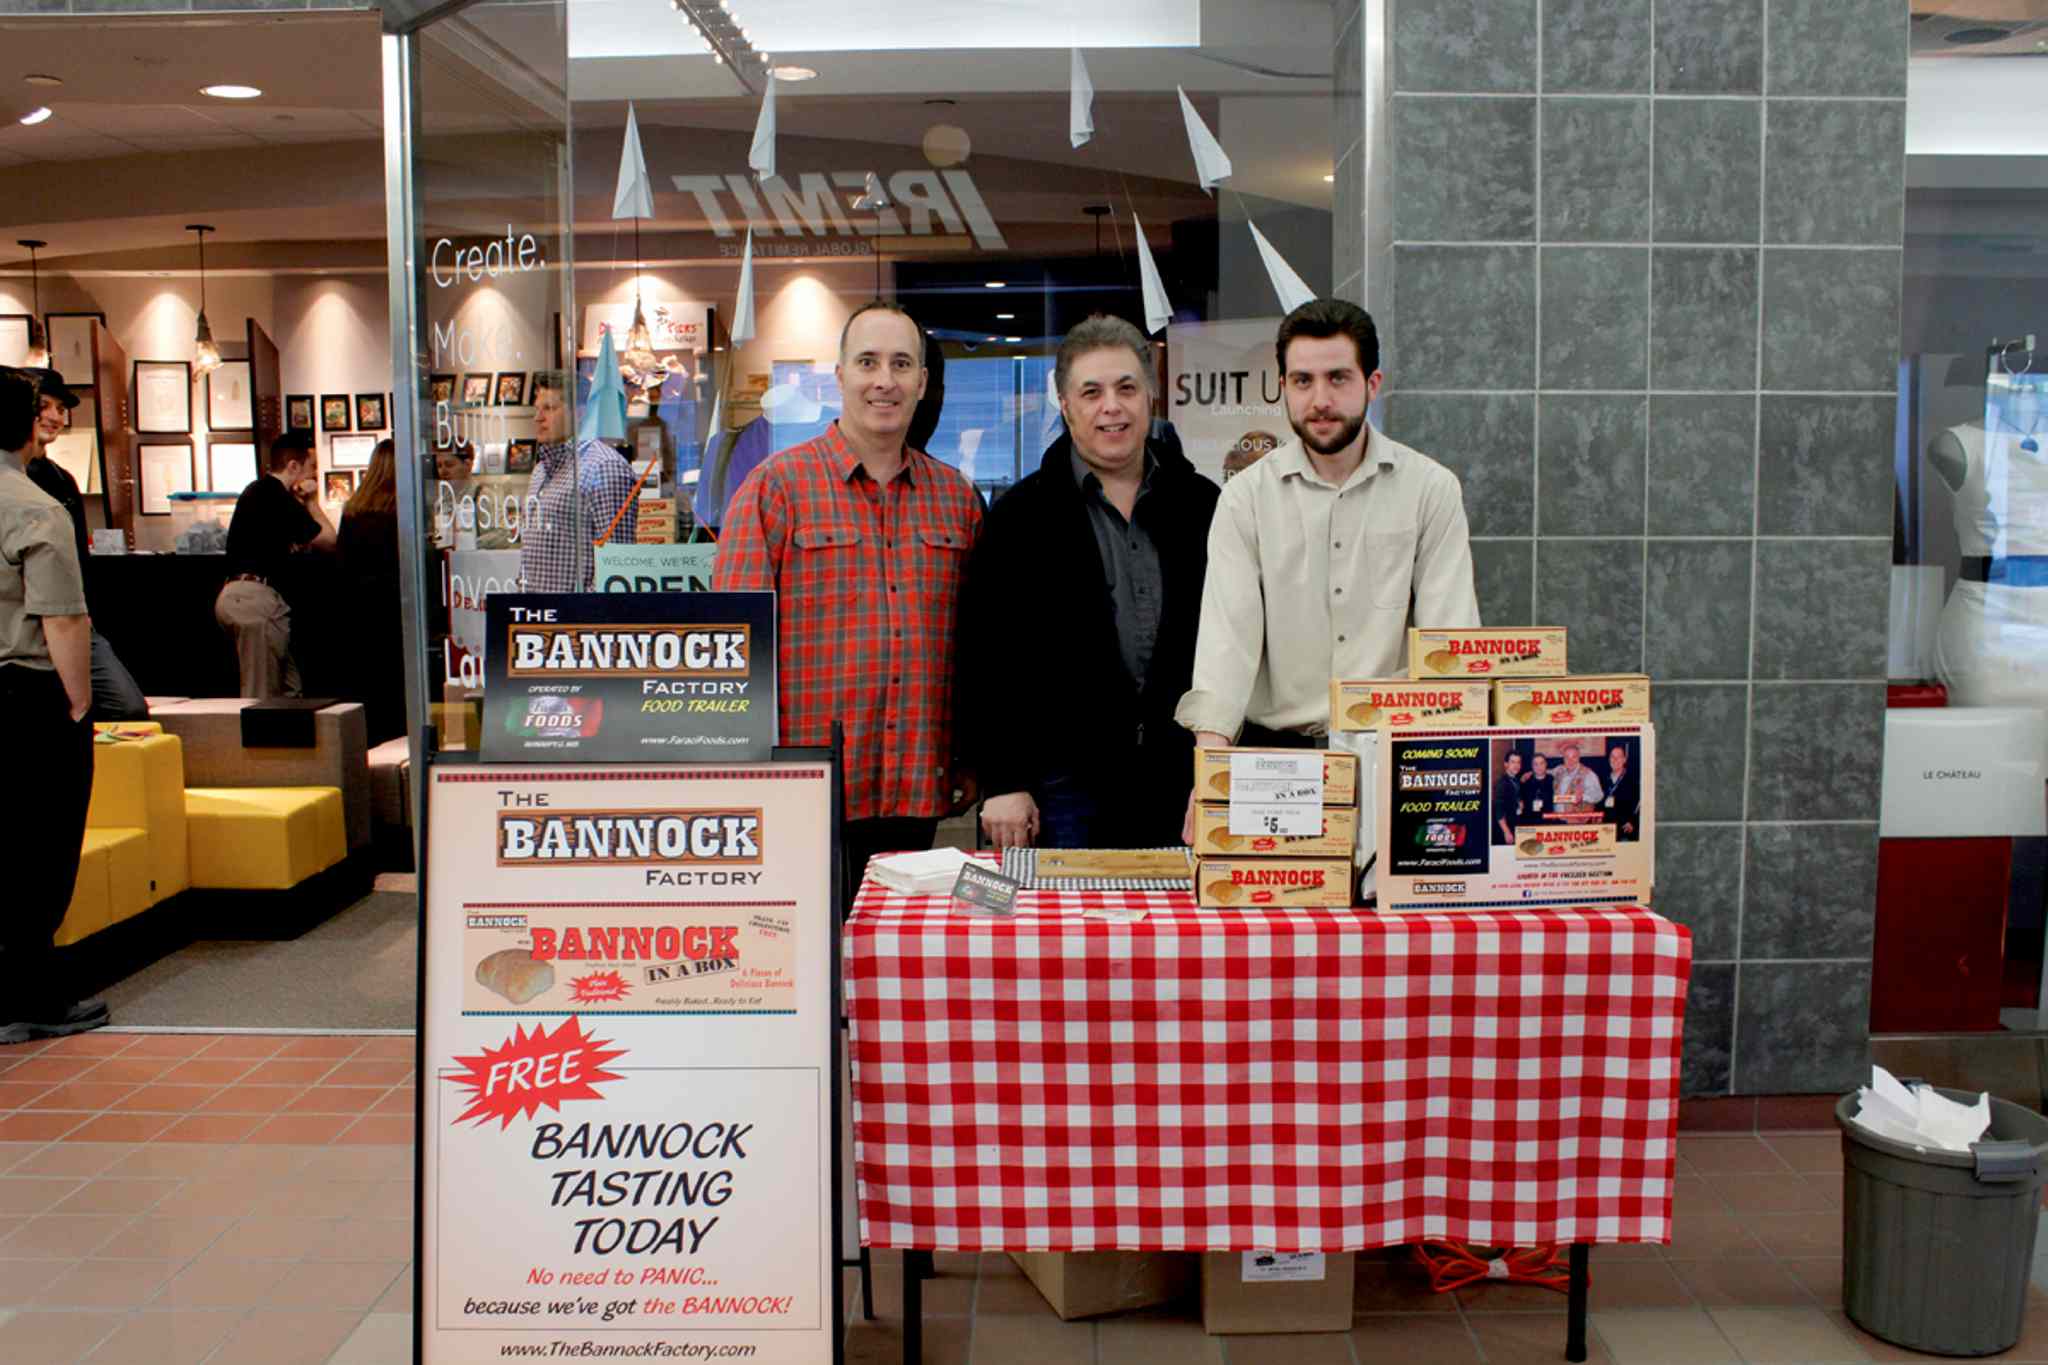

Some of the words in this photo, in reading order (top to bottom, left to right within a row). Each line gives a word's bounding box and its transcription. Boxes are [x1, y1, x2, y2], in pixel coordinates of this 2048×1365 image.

[432, 223, 546, 288] Create.
[1175, 371, 1249, 406] SUIT
[1211, 404, 1281, 418] Launching
[438, 479, 552, 543] Design.
[509, 607, 557, 622] THE
[514, 633, 746, 669] BANNOCK
[1448, 639, 1541, 656] BANNOCK
[642, 680, 749, 695] FACTORY
[1371, 692, 1463, 708] BANNOCK
[1531, 689, 1623, 705] BANNOCK
[640, 700, 683, 713] FOOD
[687, 700, 749, 713] TRAILER
[524, 714, 583, 727] FOODS
[1402, 749, 1443, 759] COMING
[1445, 748, 1479, 758] SOON!
[1402, 773, 1480, 788] BANNOCK
[1923, 770, 1933, 780] LE
[498, 791, 549, 806] THE
[1400, 802, 1431, 812] FOOD
[1435, 801, 1480, 812] TRAILER
[503, 816, 758, 858] BANNOCK
[1536, 831, 1598, 843] BANNOCK
[645, 871, 763, 886] FACTORY
[1232, 870, 1325, 887] BANNOCK
[1415, 882, 1465, 893] BANNOCK
[468, 917, 528, 927] BANNOCK
[530, 926, 740, 961] BANNOCK
[648, 966, 671, 981] IN
[678, 964, 689, 977] A
[695, 958, 736, 974] BOX
[485, 1048, 584, 1097] FREE
[530, 1122, 754, 1160] BANNOCK
[550, 1170, 734, 1207] TASTING
[573, 1216, 719, 1255] TODAY
[527, 1268, 554, 1286] No
[560, 1267, 609, 1286] need
[614, 1269, 634, 1286] to
[640, 1267, 719, 1286] PANIC...
[464, 1297, 541, 1315] because
[547, 1297, 599, 1315] we've
[601, 1299, 637, 1321] got
[643, 1297, 675, 1315] the
[681, 1296, 793, 1315] BANNOCK!
[500, 1341, 756, 1361] www.TheBannockFactory.com
